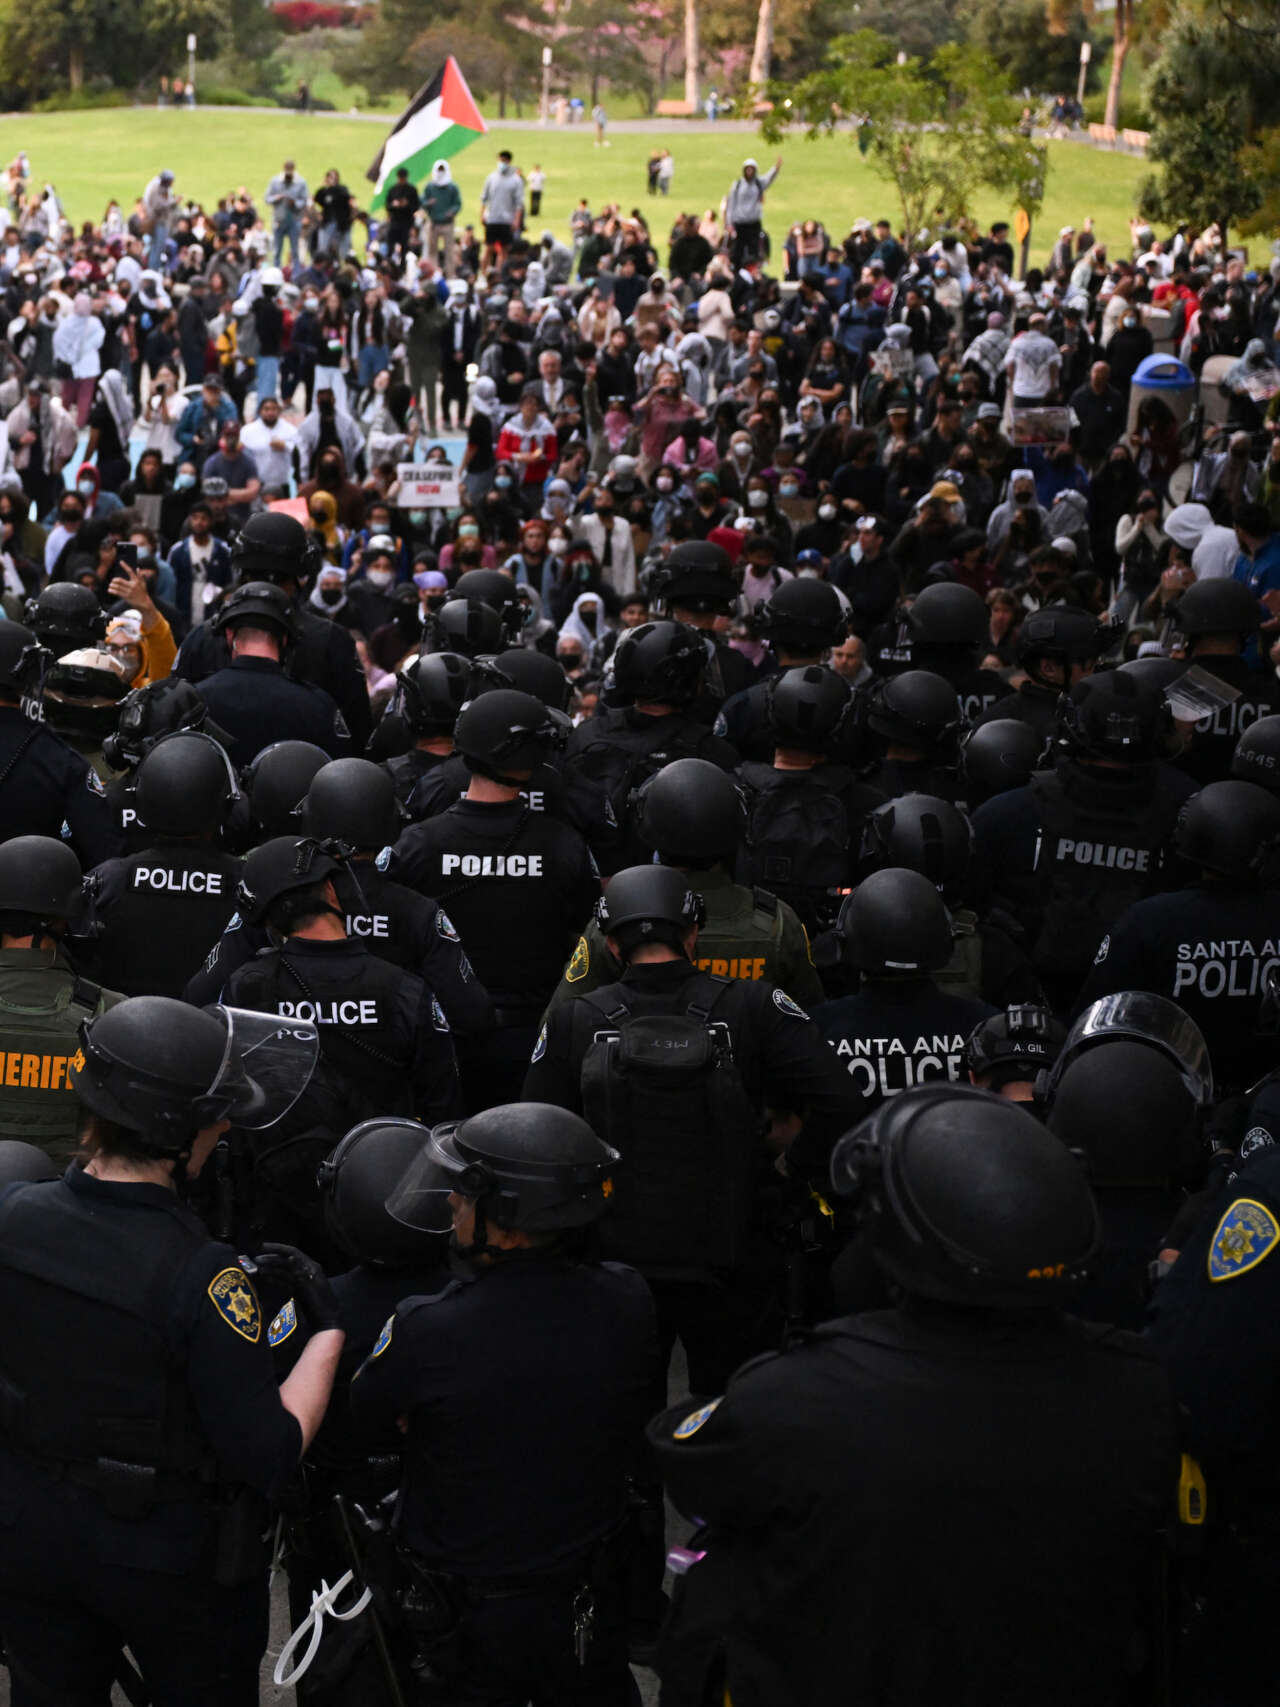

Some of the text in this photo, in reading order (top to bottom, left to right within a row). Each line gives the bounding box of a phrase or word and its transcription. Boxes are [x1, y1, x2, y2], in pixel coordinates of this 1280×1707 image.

[441, 853, 544, 877] POLICE
[1055, 837, 1151, 873] POLICE
[133, 867, 223, 894] POLICE
[1176, 939, 1257, 961] SANTA
[1172, 957, 1280, 998] POLIC
[278, 1000, 379, 1025] POLICE
[827, 1034, 966, 1057] ANTA ANA
[1027, 1043, 1046, 1054] GIL
